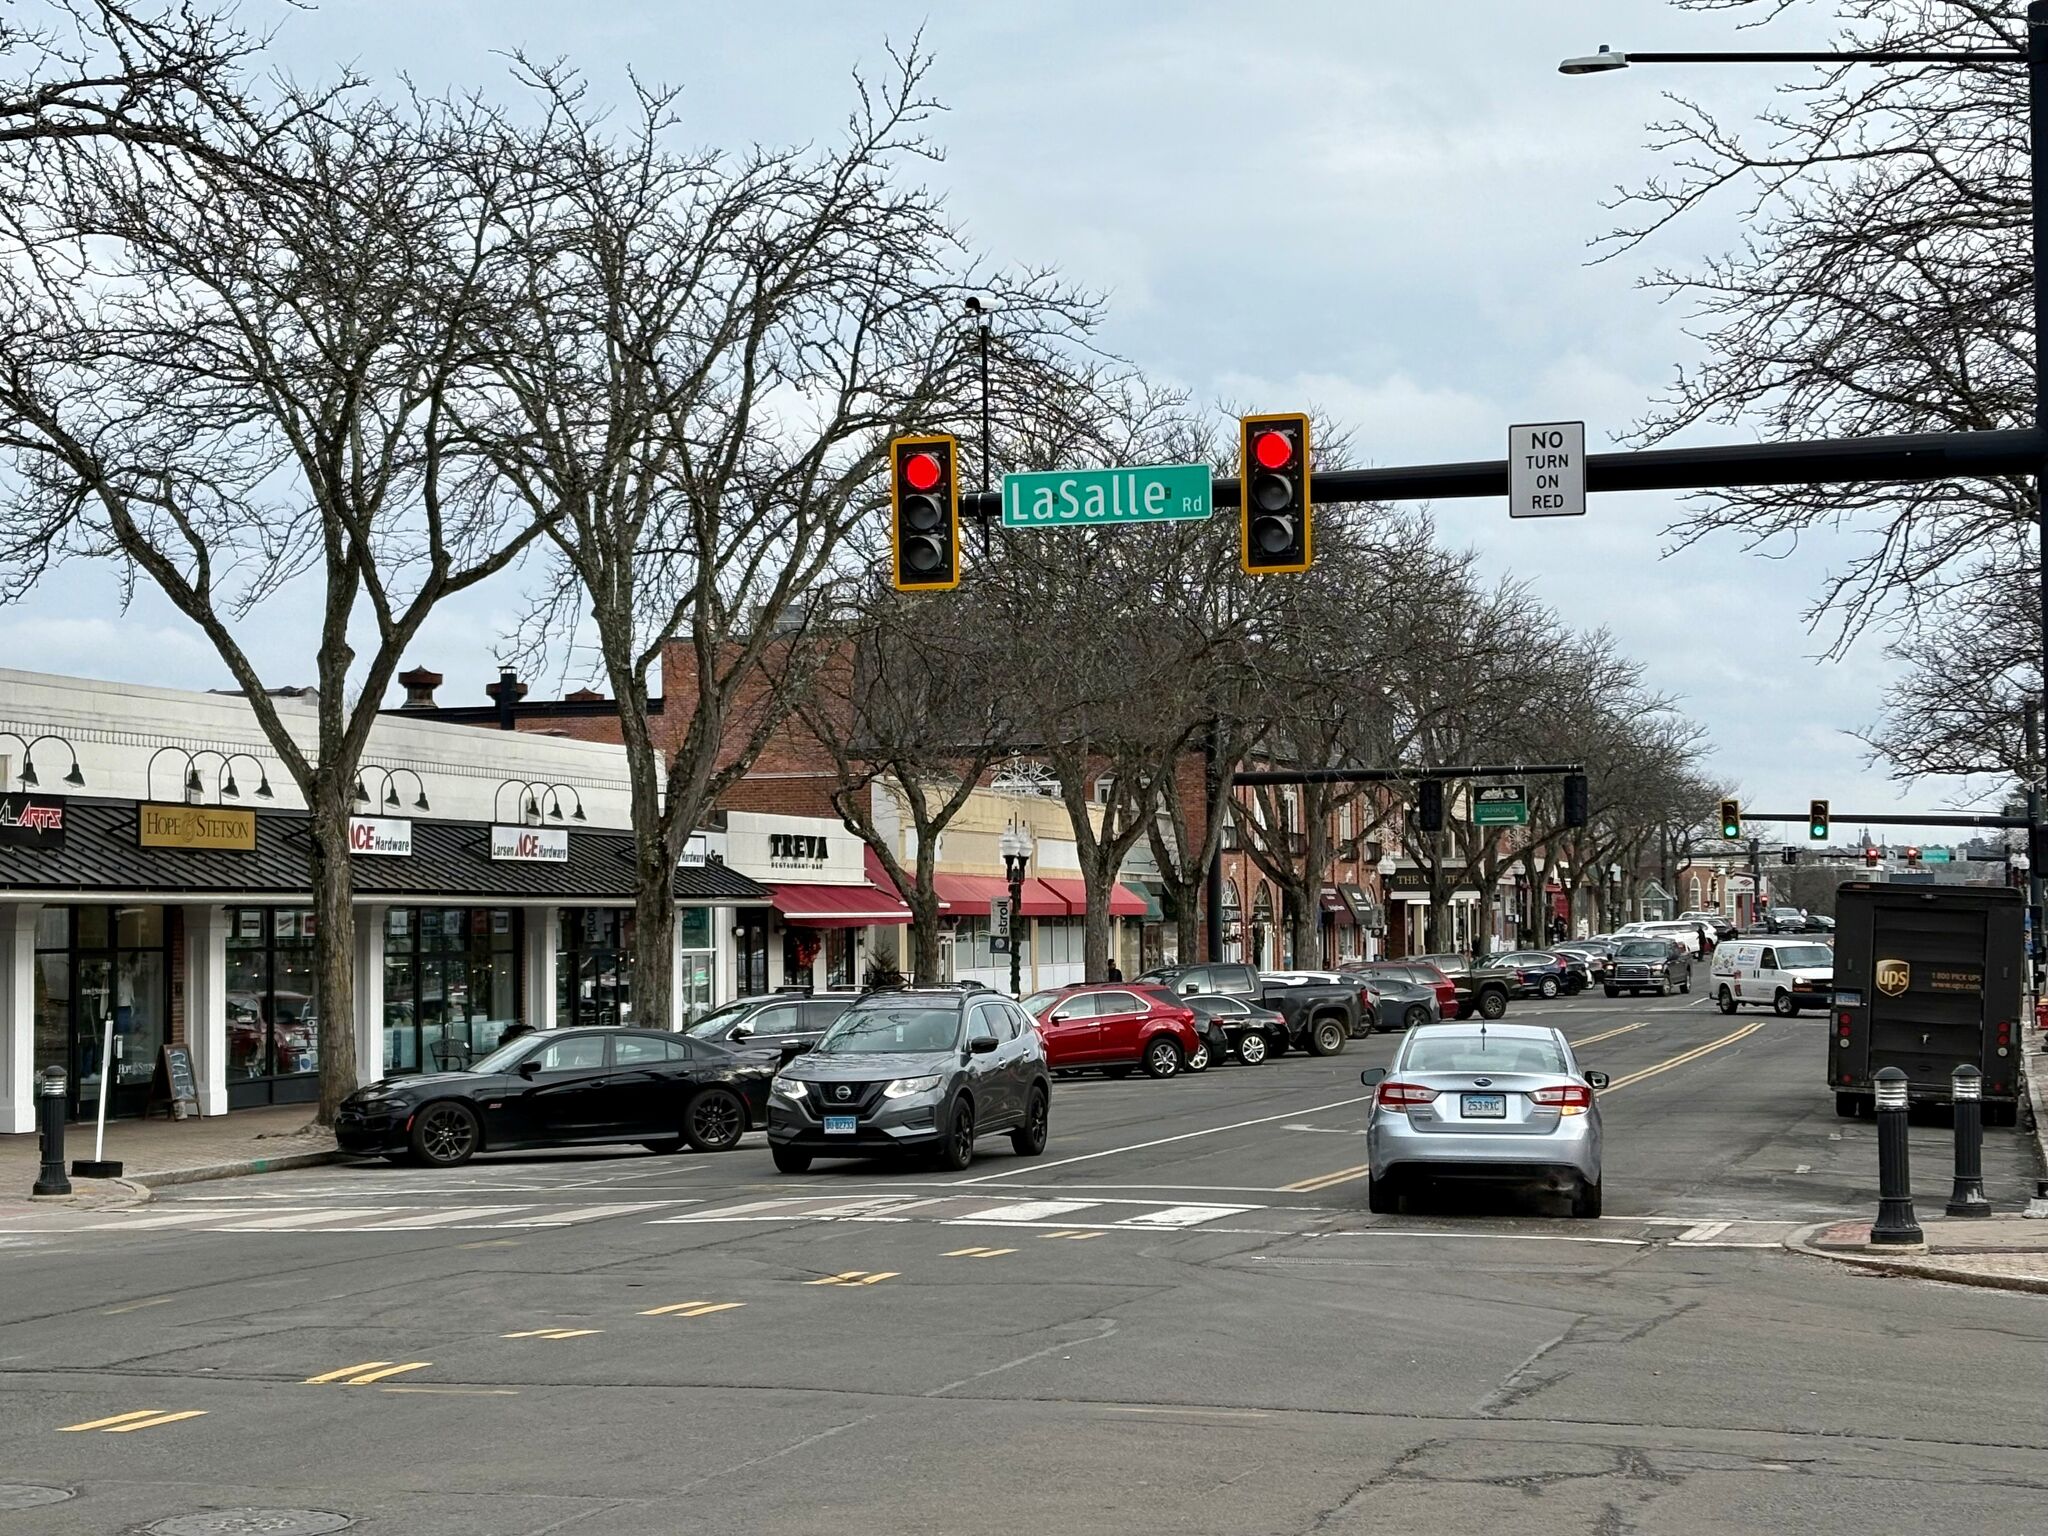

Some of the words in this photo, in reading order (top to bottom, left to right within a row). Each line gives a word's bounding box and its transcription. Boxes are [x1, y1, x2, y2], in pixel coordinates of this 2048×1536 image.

[1531, 431, 1563, 449] NO
[1526, 454, 1569, 469] TURN
[1536, 474, 1559, 489] ON
[1011, 474, 1166, 521] LaSalle
[1182, 496, 1203, 513] Rd
[1532, 494, 1564, 509] RED
[196, 815, 249, 839] STETSON
[375, 835, 410, 852] Hardware
[492, 841, 515, 857] Larsen
[515, 831, 539, 858] ACE
[538, 844, 567, 859] Hardware
[769, 833, 829, 859] TREVA
[1396, 874, 1420, 885] THE
[997, 901, 1009, 935] stroll
[1879, 970, 1908, 991] ups
